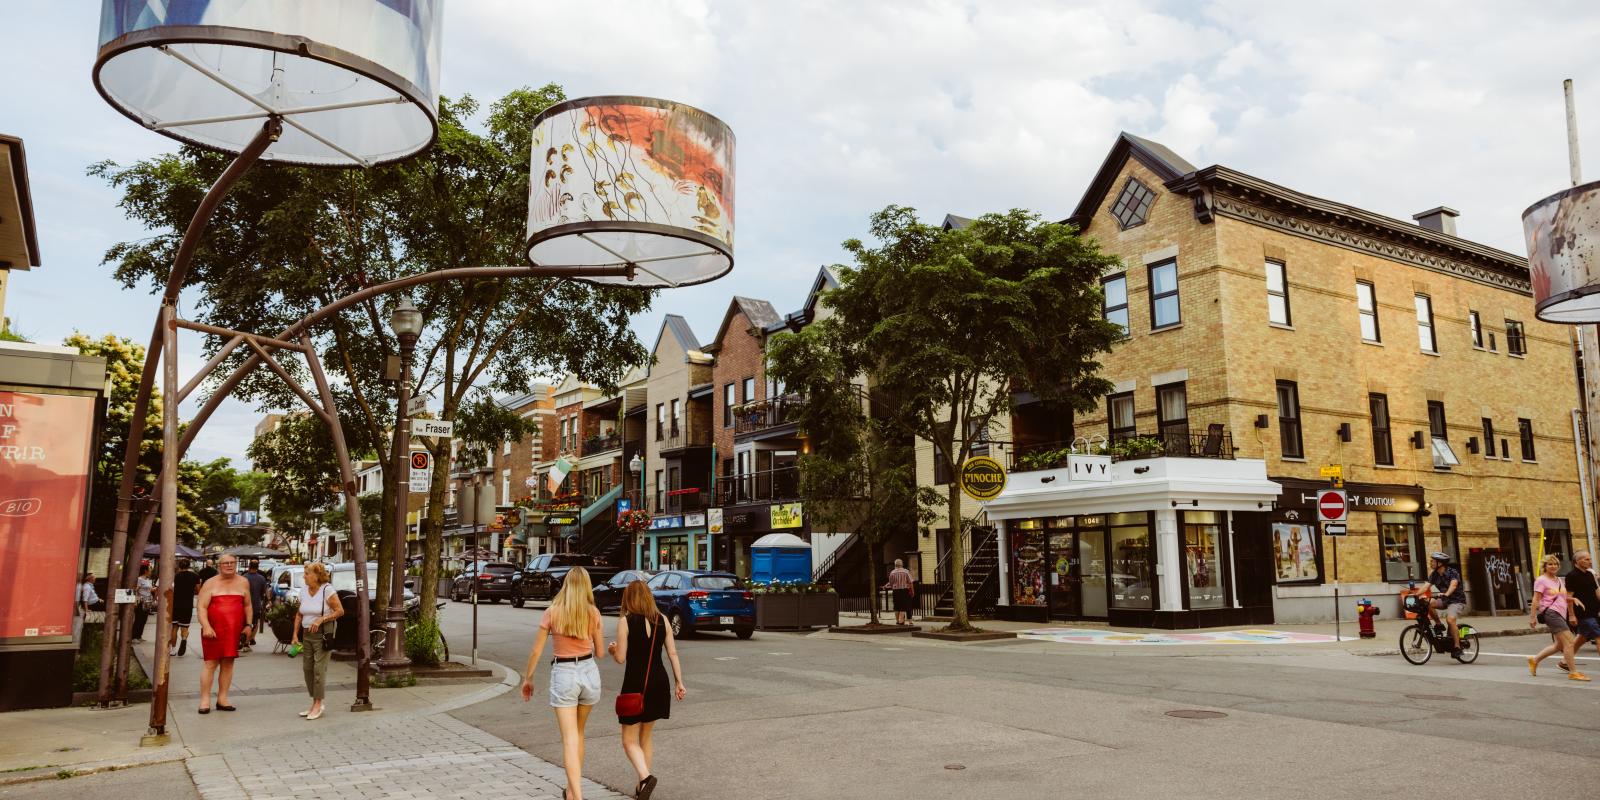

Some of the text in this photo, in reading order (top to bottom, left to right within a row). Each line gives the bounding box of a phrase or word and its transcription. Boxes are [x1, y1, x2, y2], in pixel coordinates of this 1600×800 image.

[425, 423, 451, 434] Fraser
[1075, 463, 1106, 474] IVY
[964, 473, 1002, 483] PINOCHE
[6, 502, 32, 513] BIO
[548, 517, 575, 525] SUBWAY
